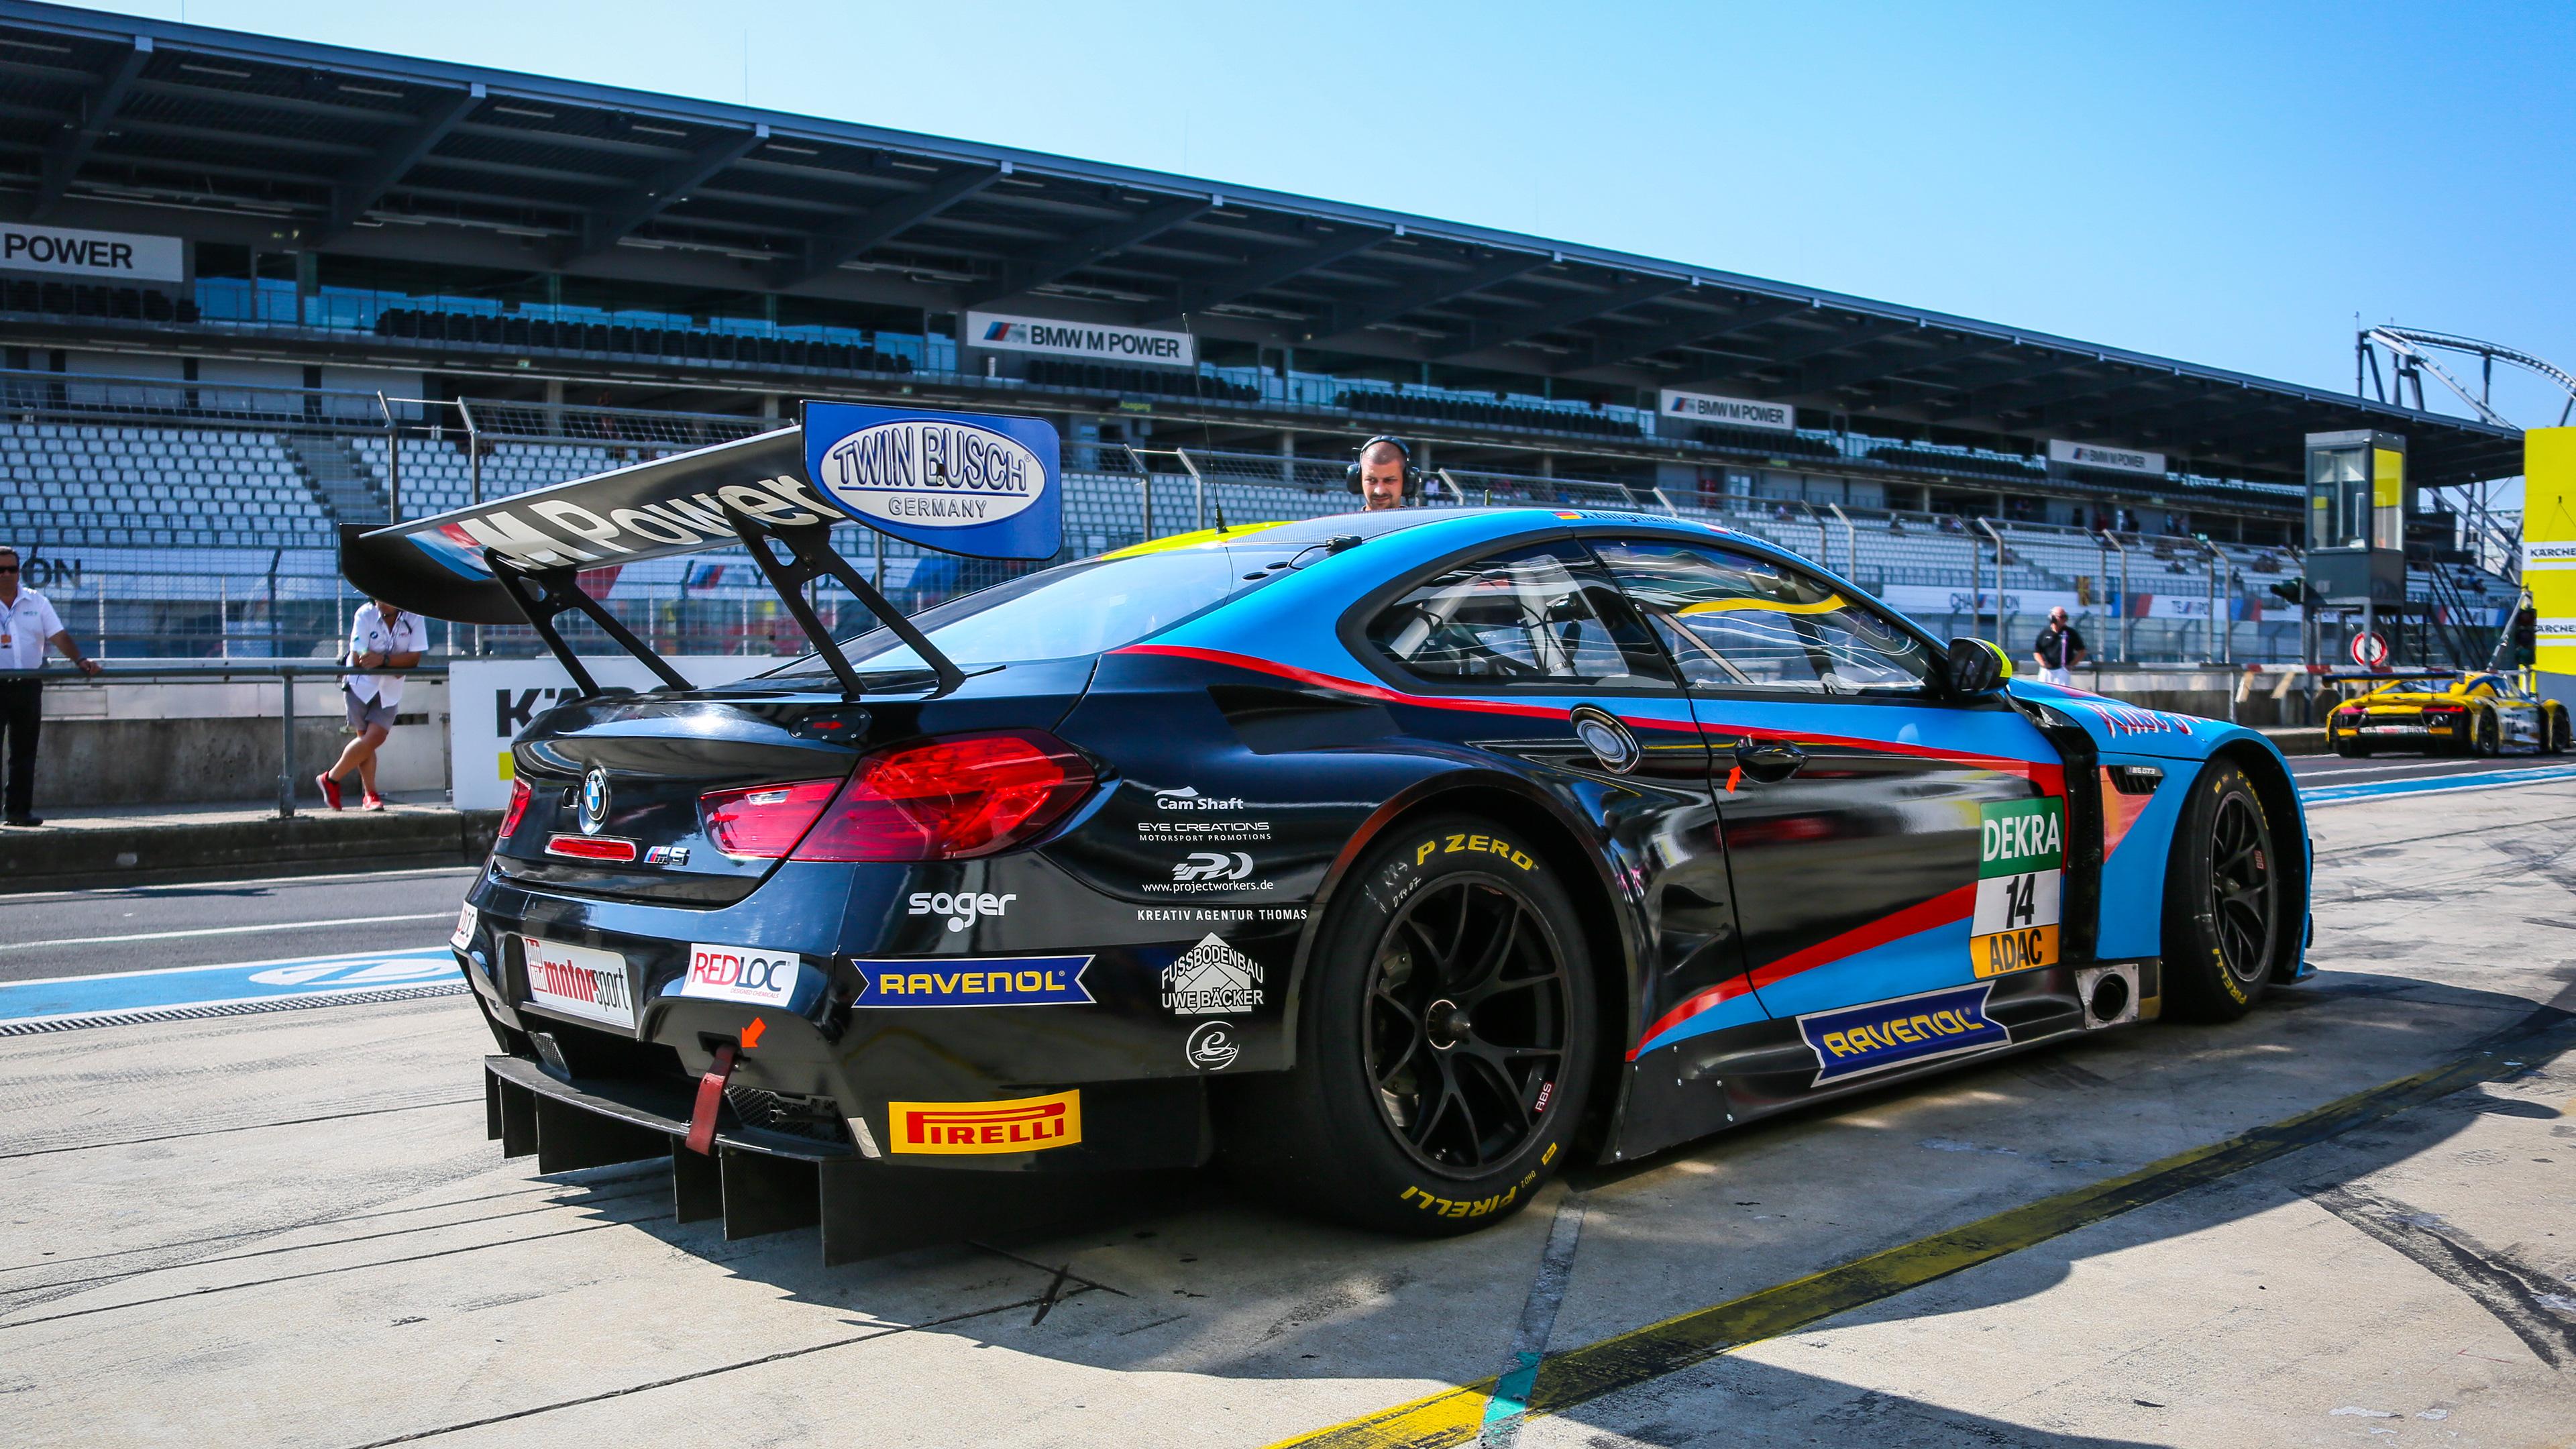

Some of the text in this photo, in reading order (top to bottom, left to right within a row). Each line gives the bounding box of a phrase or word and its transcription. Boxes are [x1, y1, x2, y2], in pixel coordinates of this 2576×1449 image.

[5, 233, 133, 268] POWER
[1031, 325, 1179, 358] BMW M POWER
[1697, 400, 1784, 424] BMW M POWER
[833, 426, 1026, 491] TWIN BUSCH
[528, 475, 847, 554] Power
[888, 496, 987, 518] GERMANY
[1157, 798, 1244, 810] Cam Shaft
[1138, 822, 1270, 832] EYE CREATIONS
[1208, 833, 1271, 841] PROMOTIONS
[1983, 812, 2061, 862] DEKRA
[1417, 833, 1534, 871] P ZERO
[1142, 880, 1274, 894] www.projectworkers.de
[2006, 873, 2035, 929] 14
[908, 892, 1017, 932] sager
[1137, 909, 1307, 920] KREATIV AGENTUR THOMAS
[1161, 945, 1263, 989] FUSSBODENBAU
[1990, 928, 2043, 973] ADAC
[543, 959, 629, 1012] motorsport
[691, 953, 787, 992] REDLOC
[880, 970, 1066, 994] RAVENOL
[1162, 987, 1265, 1008] UWE BÄCKER
[1823, 1008, 1984, 1058] RAVENOL
[906, 1102, 1066, 1144] PIRELLI
[1400, 1185, 1517, 1218] PIRELLI
